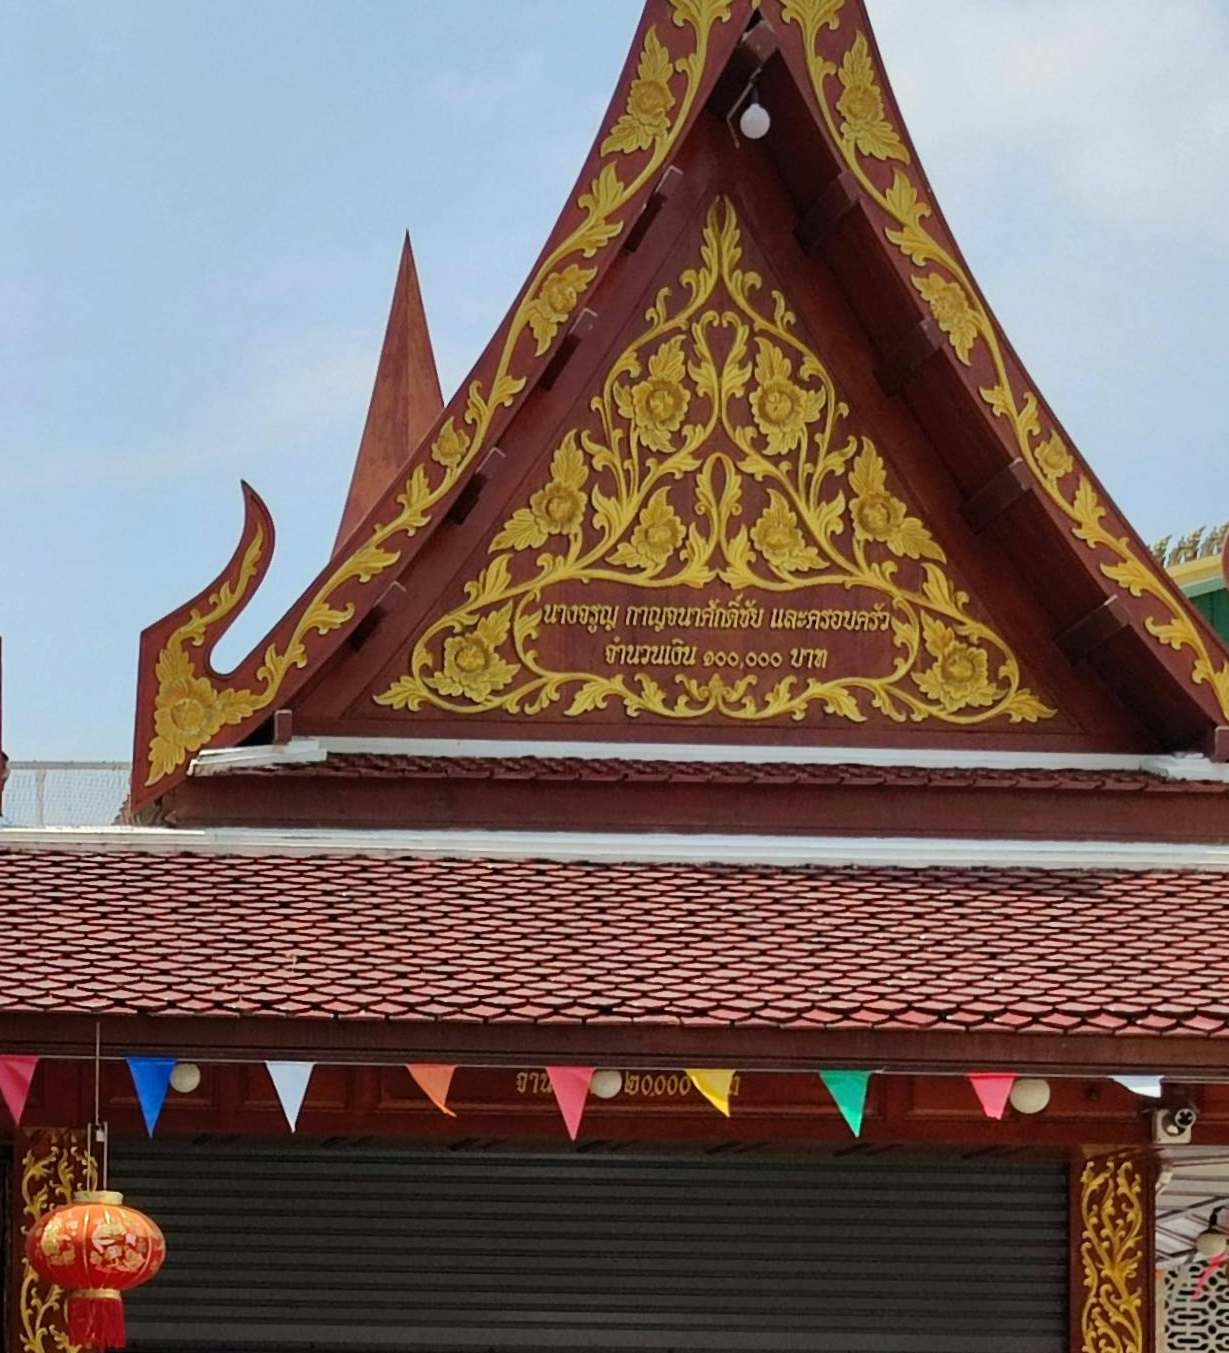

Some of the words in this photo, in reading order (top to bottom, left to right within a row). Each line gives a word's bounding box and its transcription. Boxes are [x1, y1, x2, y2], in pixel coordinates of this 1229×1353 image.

[543, 603, 619, 633] นางจรูญ
[770, 602, 890, 631] และครอบครัว
[605, 635, 697, 666] จำนวนเงิน
[790, 648, 828, 668] บาท
